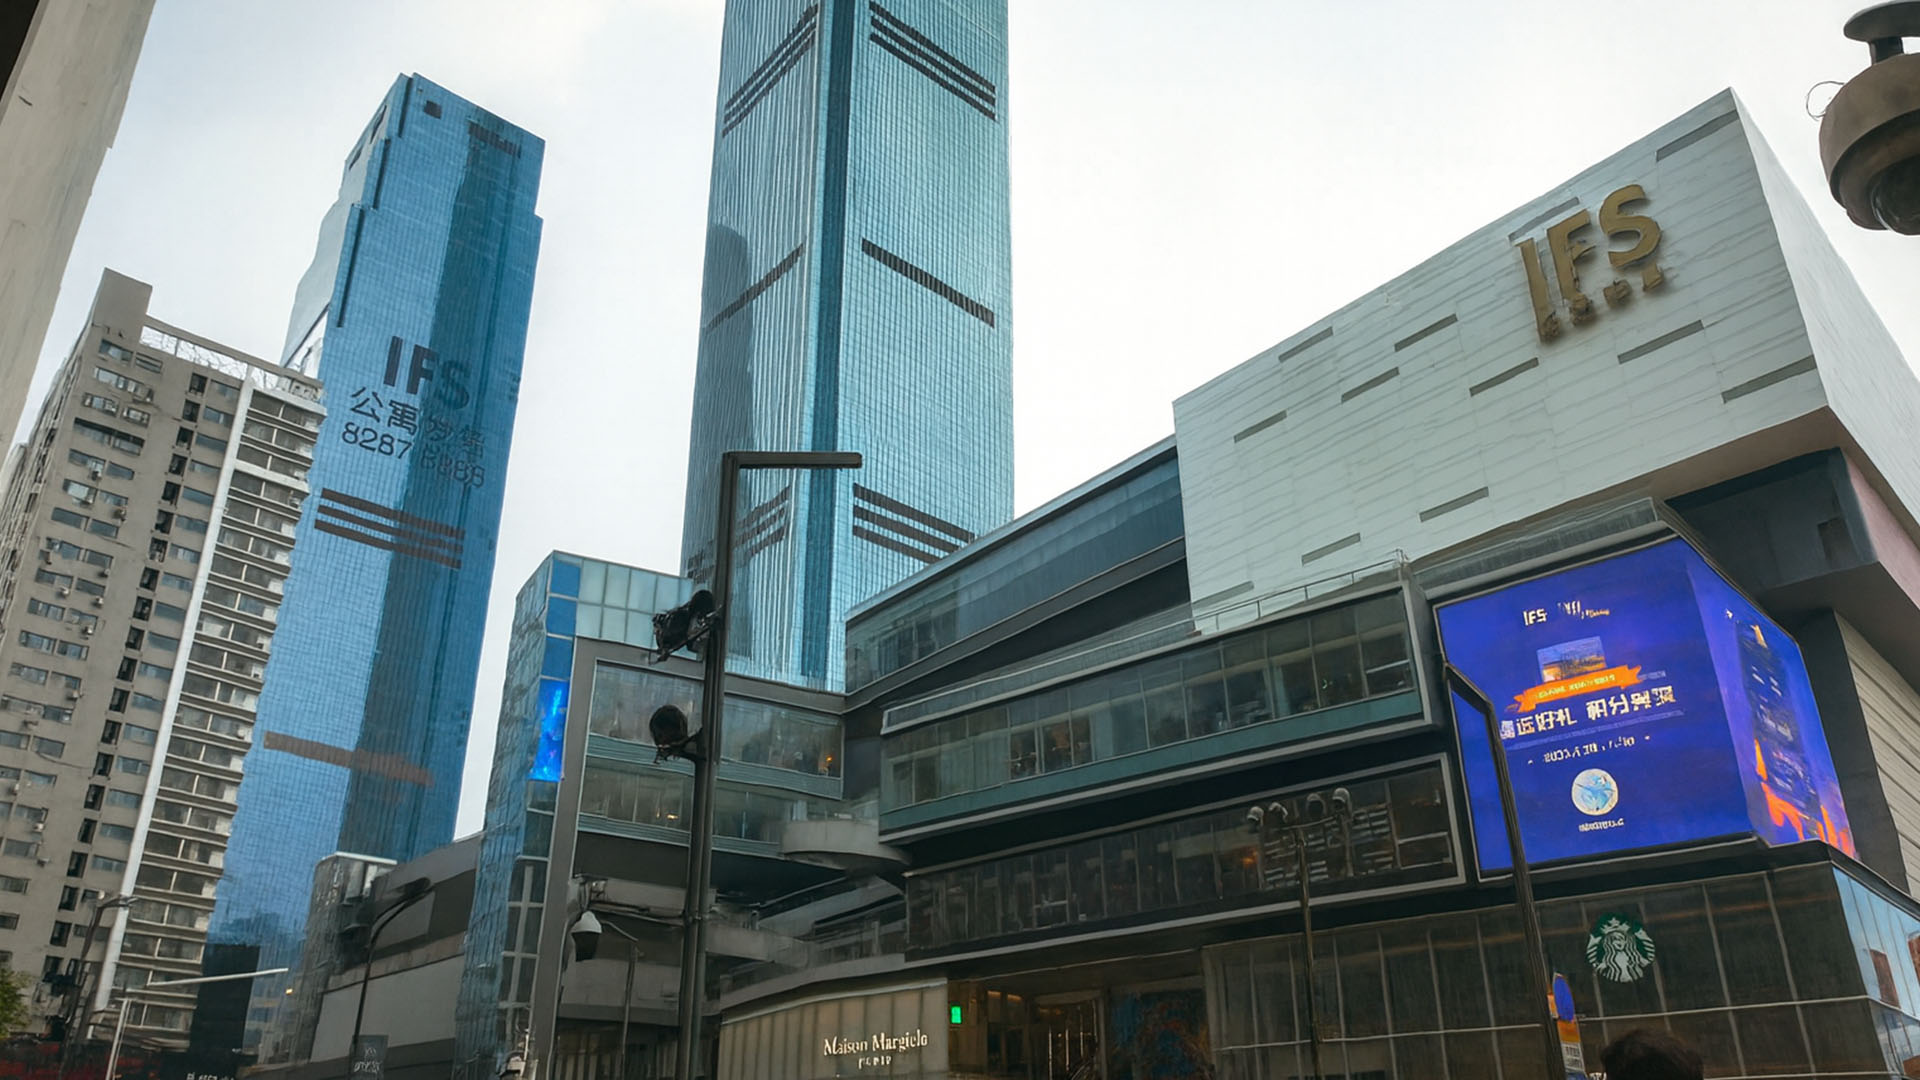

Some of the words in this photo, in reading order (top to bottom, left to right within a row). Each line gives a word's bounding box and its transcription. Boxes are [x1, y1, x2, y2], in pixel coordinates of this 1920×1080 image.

[1516, 184, 1661, 328] IFS
[383, 335, 470, 410] IFS
[342, 422, 412, 459] 8287
[823, 1036, 868, 1056] Maison
